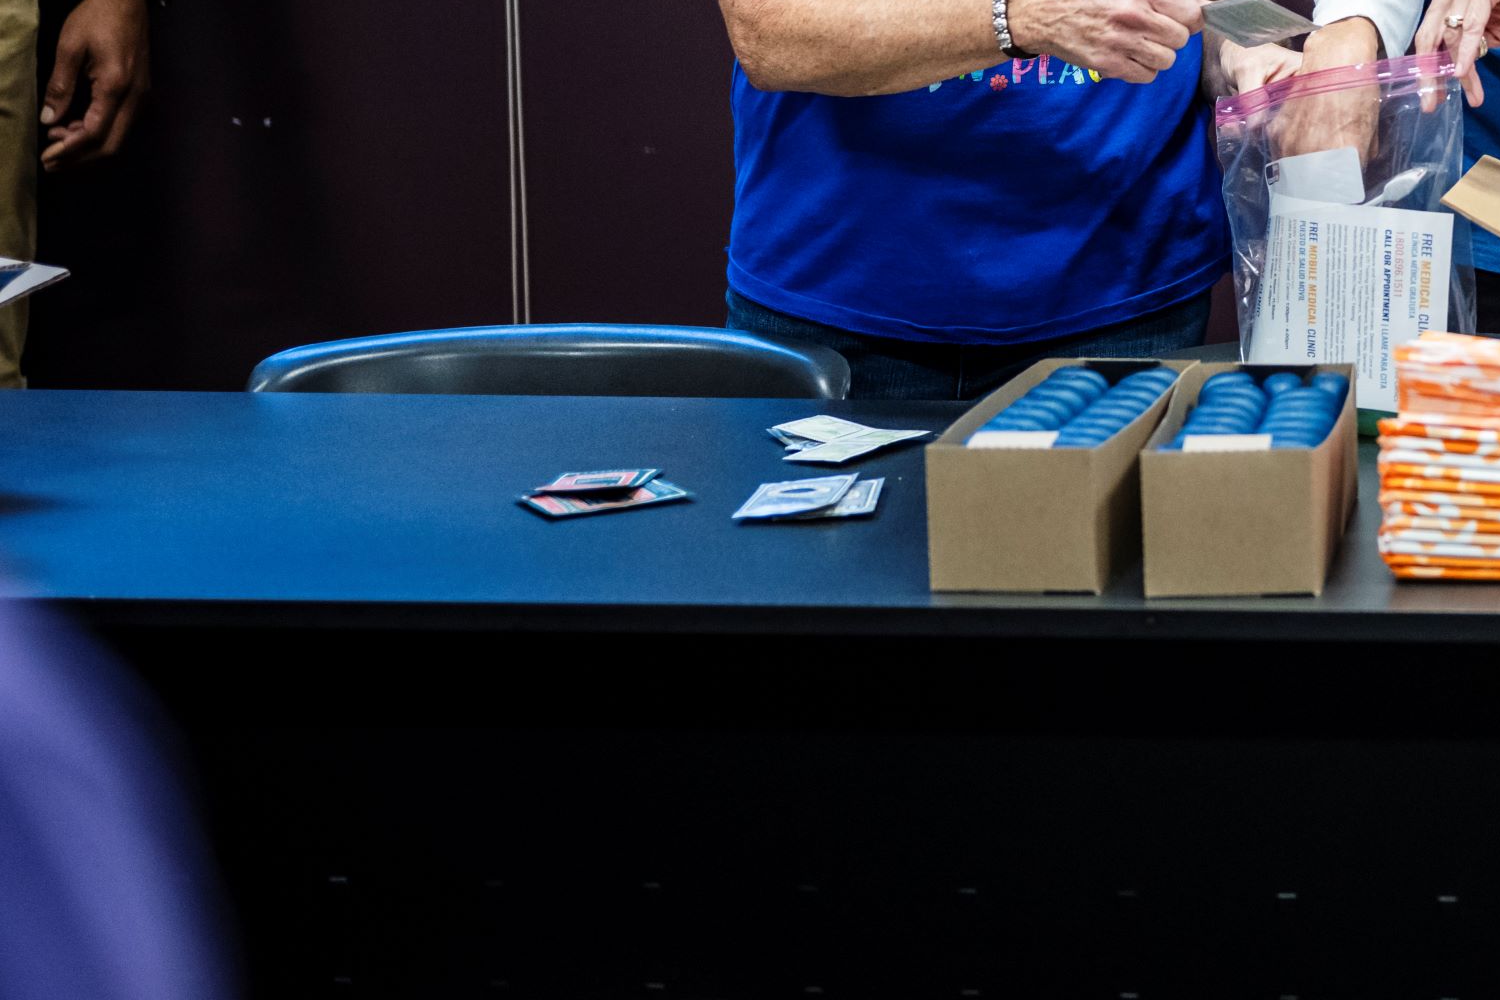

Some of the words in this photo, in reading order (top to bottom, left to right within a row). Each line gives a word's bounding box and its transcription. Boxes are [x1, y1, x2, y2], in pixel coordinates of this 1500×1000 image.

[1309, 222, 1318, 242] FREE
[1384, 230, 1392, 248] CALL
[1421, 233, 1433, 257] FREE
[1308, 245, 1318, 280] MOBILE
[1382, 268, 1391, 321] APPOINTMENT
[1419, 260, 1432, 310] MEDICAL
[1308, 284, 1317, 325] MEDICAL
[1307, 329, 1316, 358] CLINIC
